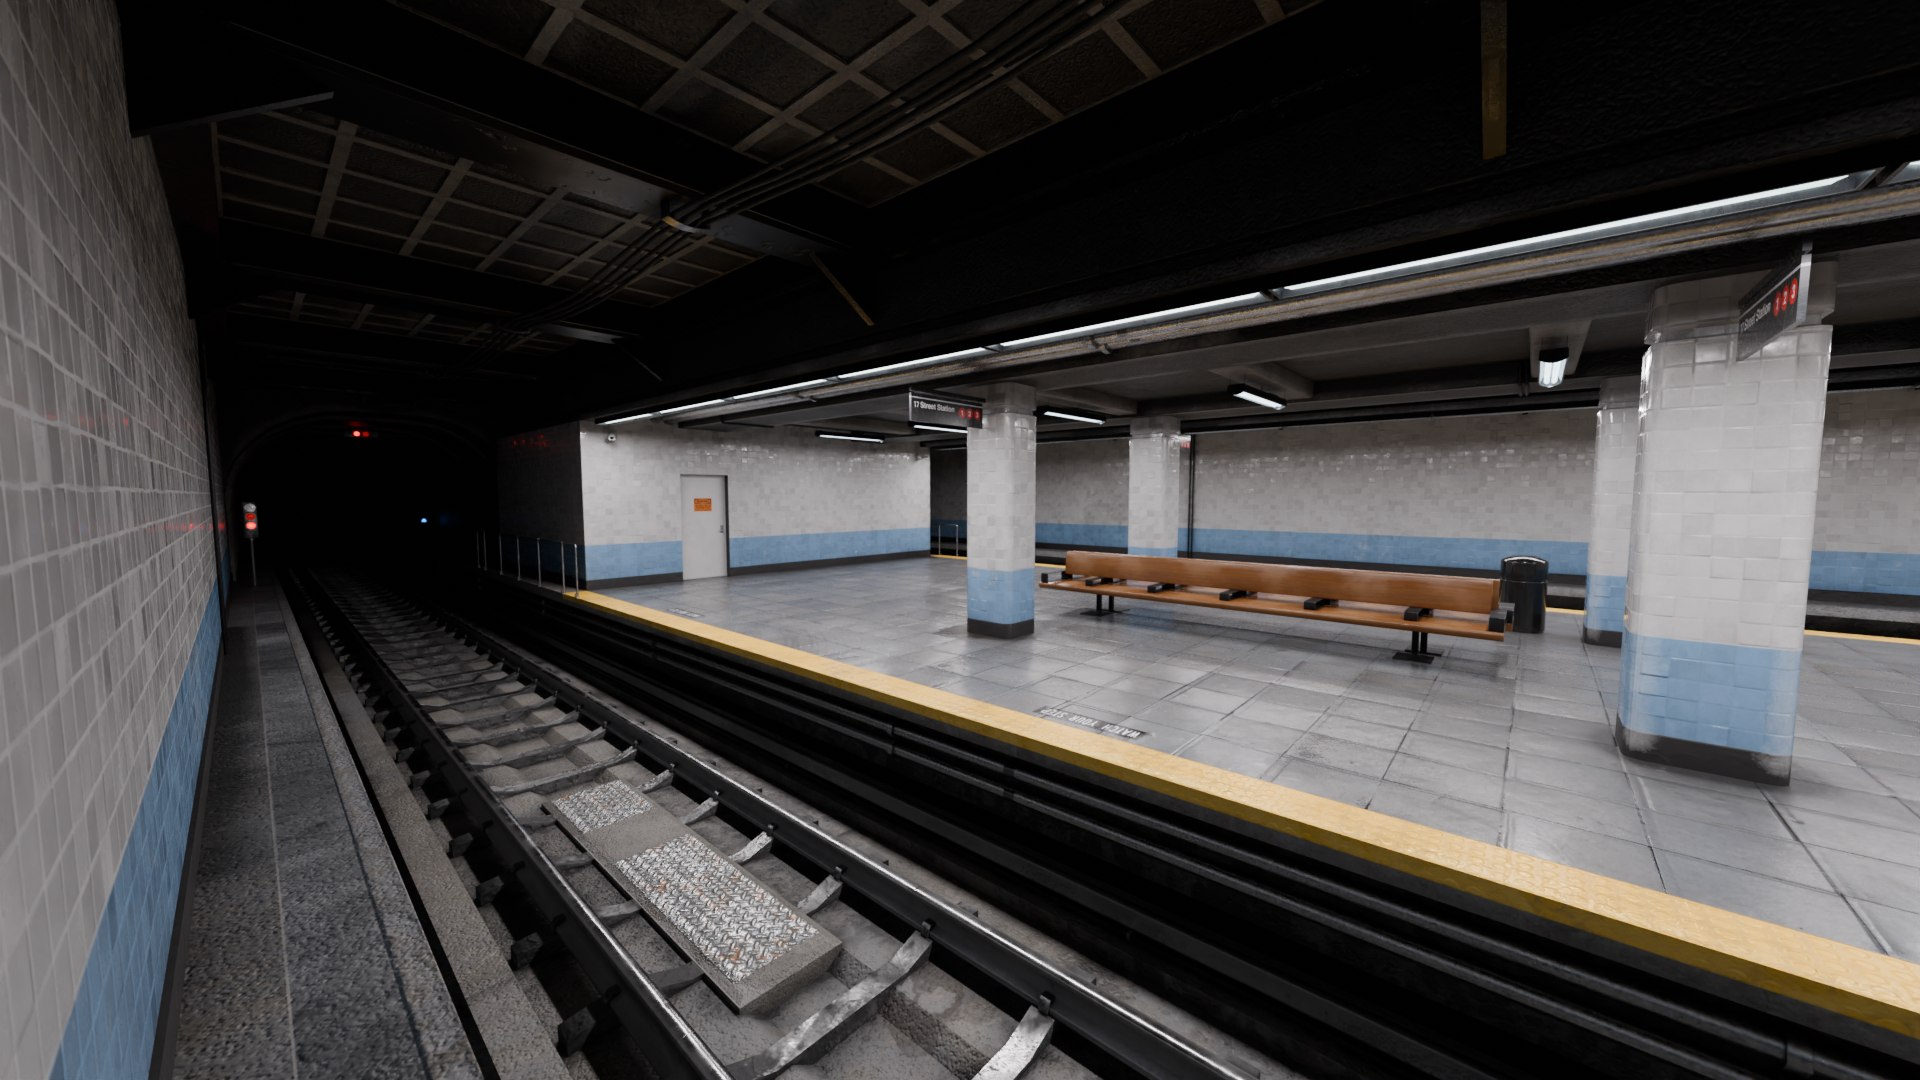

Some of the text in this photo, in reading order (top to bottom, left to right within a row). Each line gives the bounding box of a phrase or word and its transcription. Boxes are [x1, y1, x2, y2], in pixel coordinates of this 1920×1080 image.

[1756, 302, 1771, 321] Station
[913, 400, 919, 408] 17
[920, 401, 936, 411] Street
[937, 404, 955, 412] Station
[1041, 709, 1141, 738] WATCH YOUR STEP
